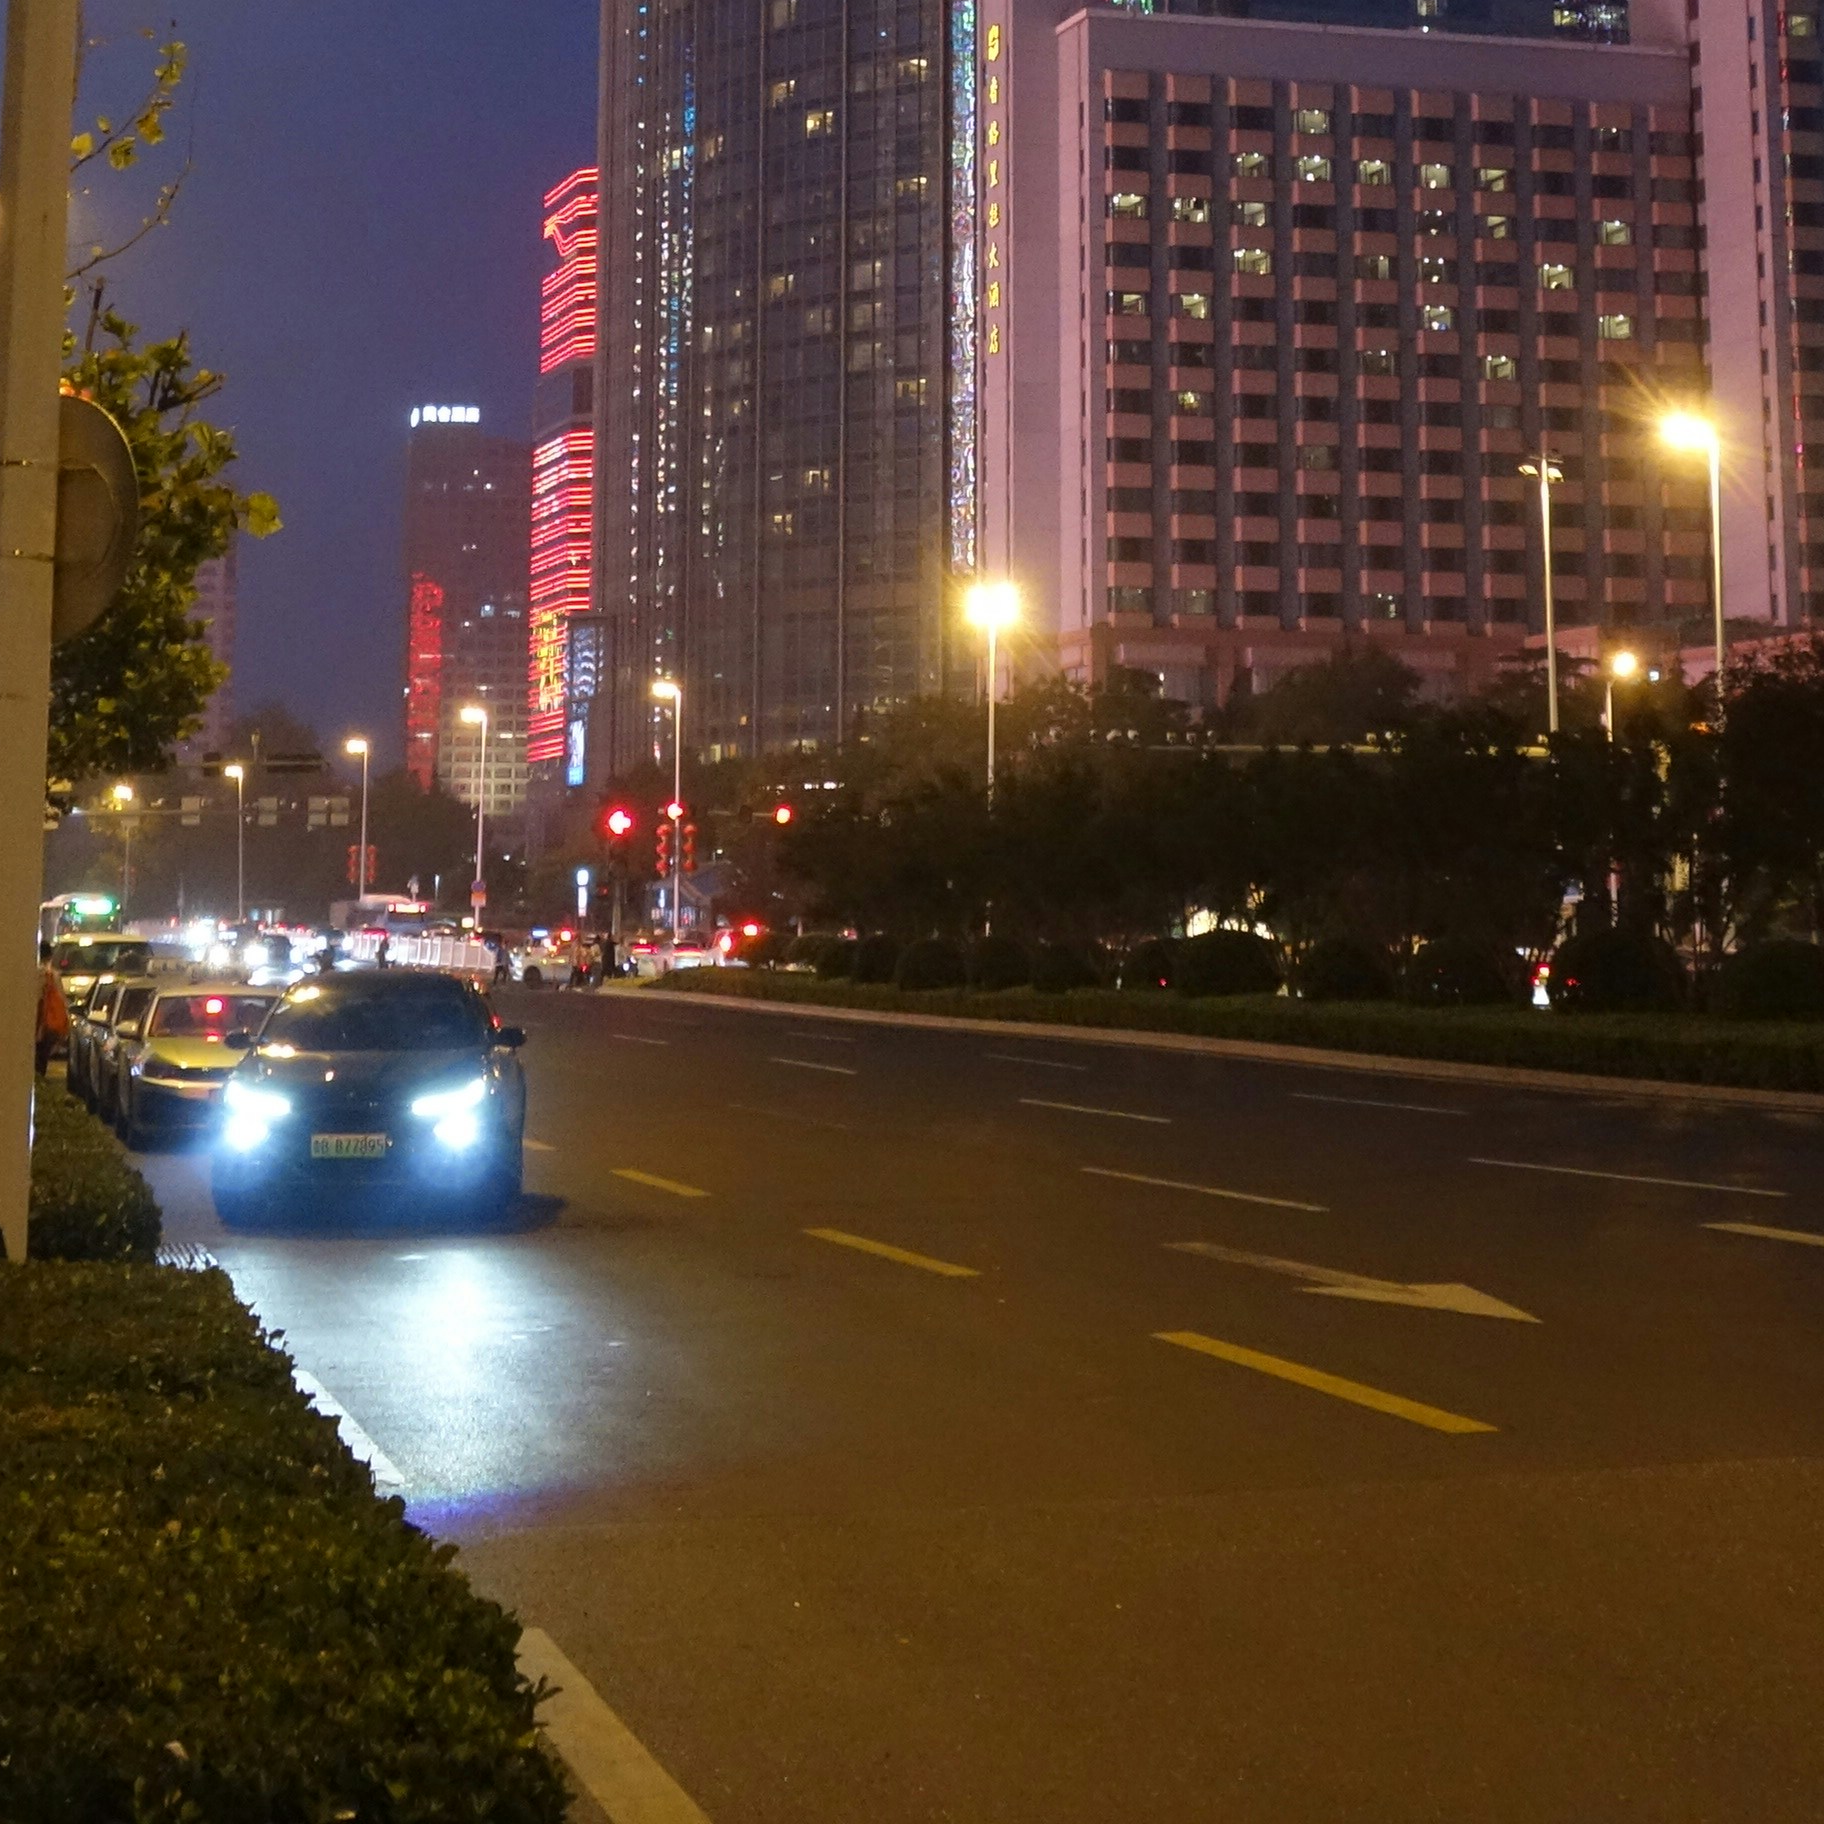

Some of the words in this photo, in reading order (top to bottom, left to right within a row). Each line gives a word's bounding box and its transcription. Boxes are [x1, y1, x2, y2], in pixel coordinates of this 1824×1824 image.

[988, 76, 1000, 354] 香格里拉大酒店
